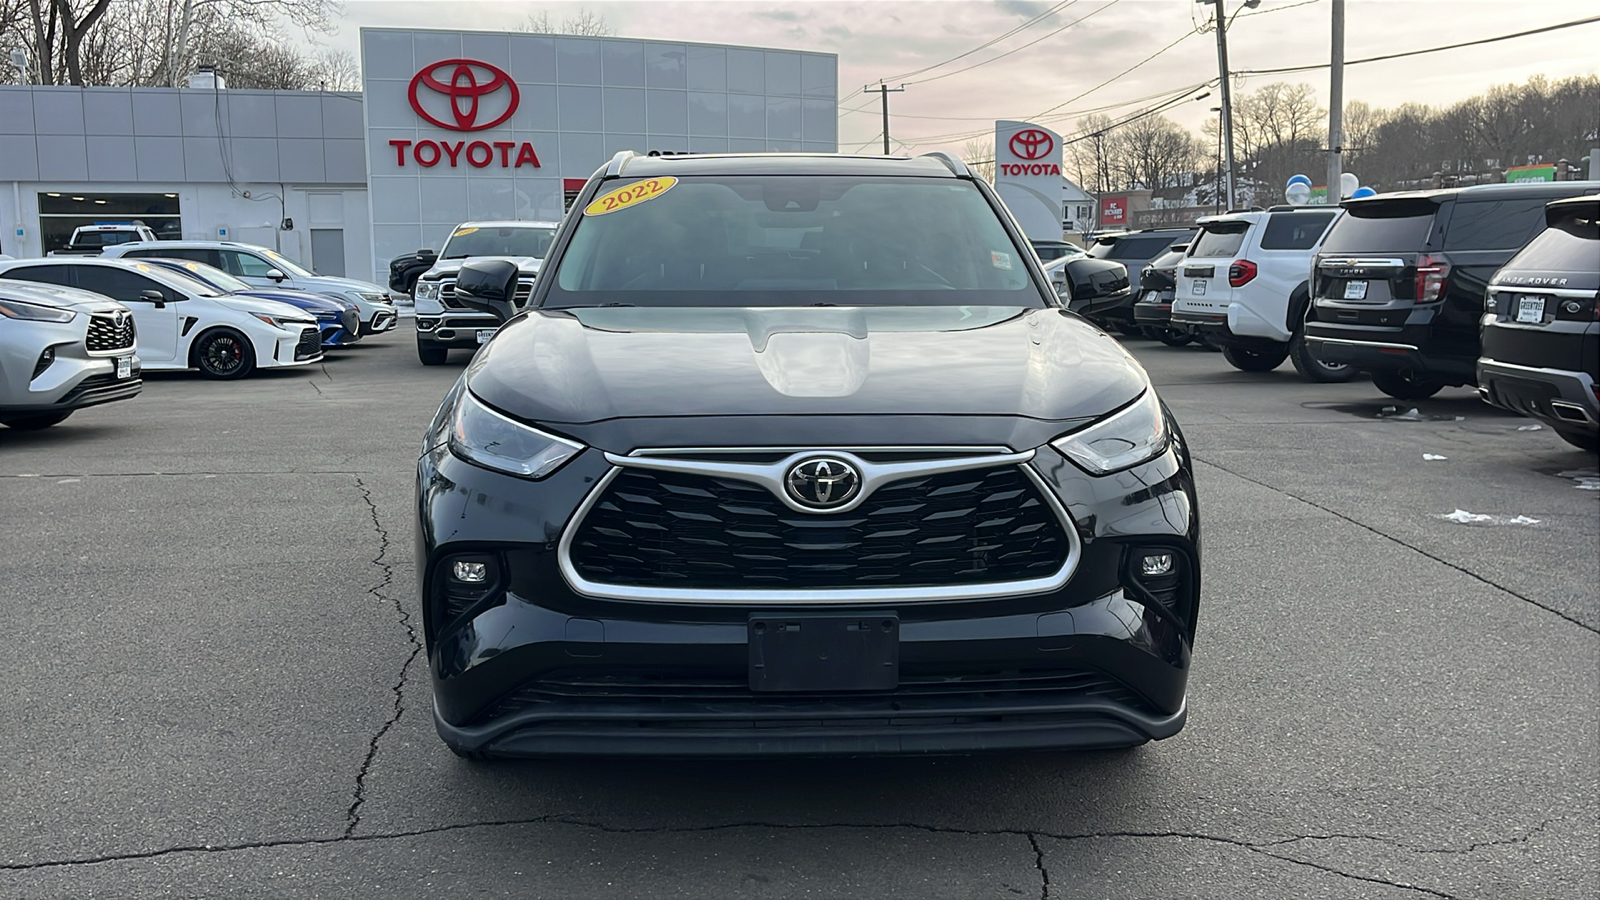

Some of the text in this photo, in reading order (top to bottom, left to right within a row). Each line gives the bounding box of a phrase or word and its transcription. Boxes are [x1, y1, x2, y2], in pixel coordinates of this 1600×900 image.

[389, 139, 541, 168] TOYOTA
[1001, 163, 1061, 176] TOYOTA
[602, 180, 663, 211] 2022
[1528, 277, 1568, 285] ROVER
[1520, 301, 1544, 311] GREENTREE
